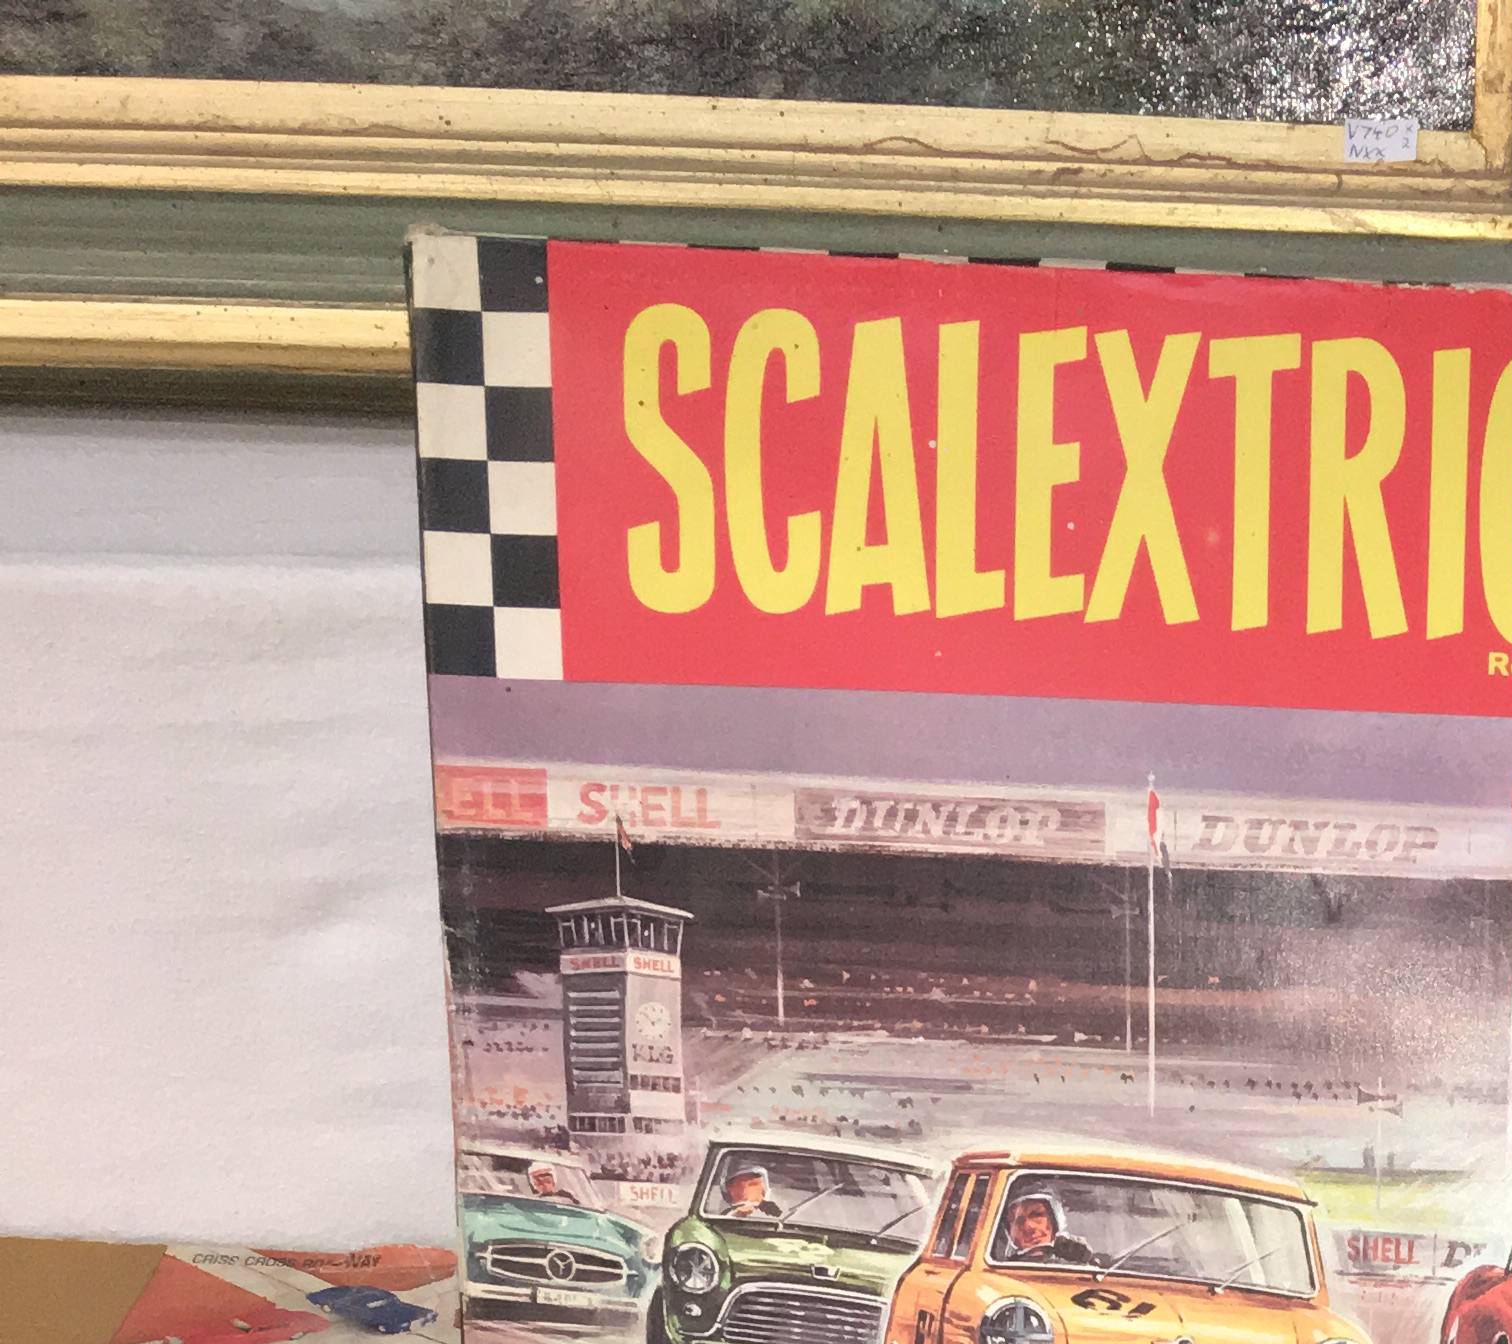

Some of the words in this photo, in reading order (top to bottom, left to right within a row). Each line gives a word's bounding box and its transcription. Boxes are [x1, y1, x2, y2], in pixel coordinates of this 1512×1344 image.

[1191, 814, 1441, 864] DUNLOP
[632, 956, 675, 974] SHELL
[1346, 1235, 1420, 1265] SHELL
